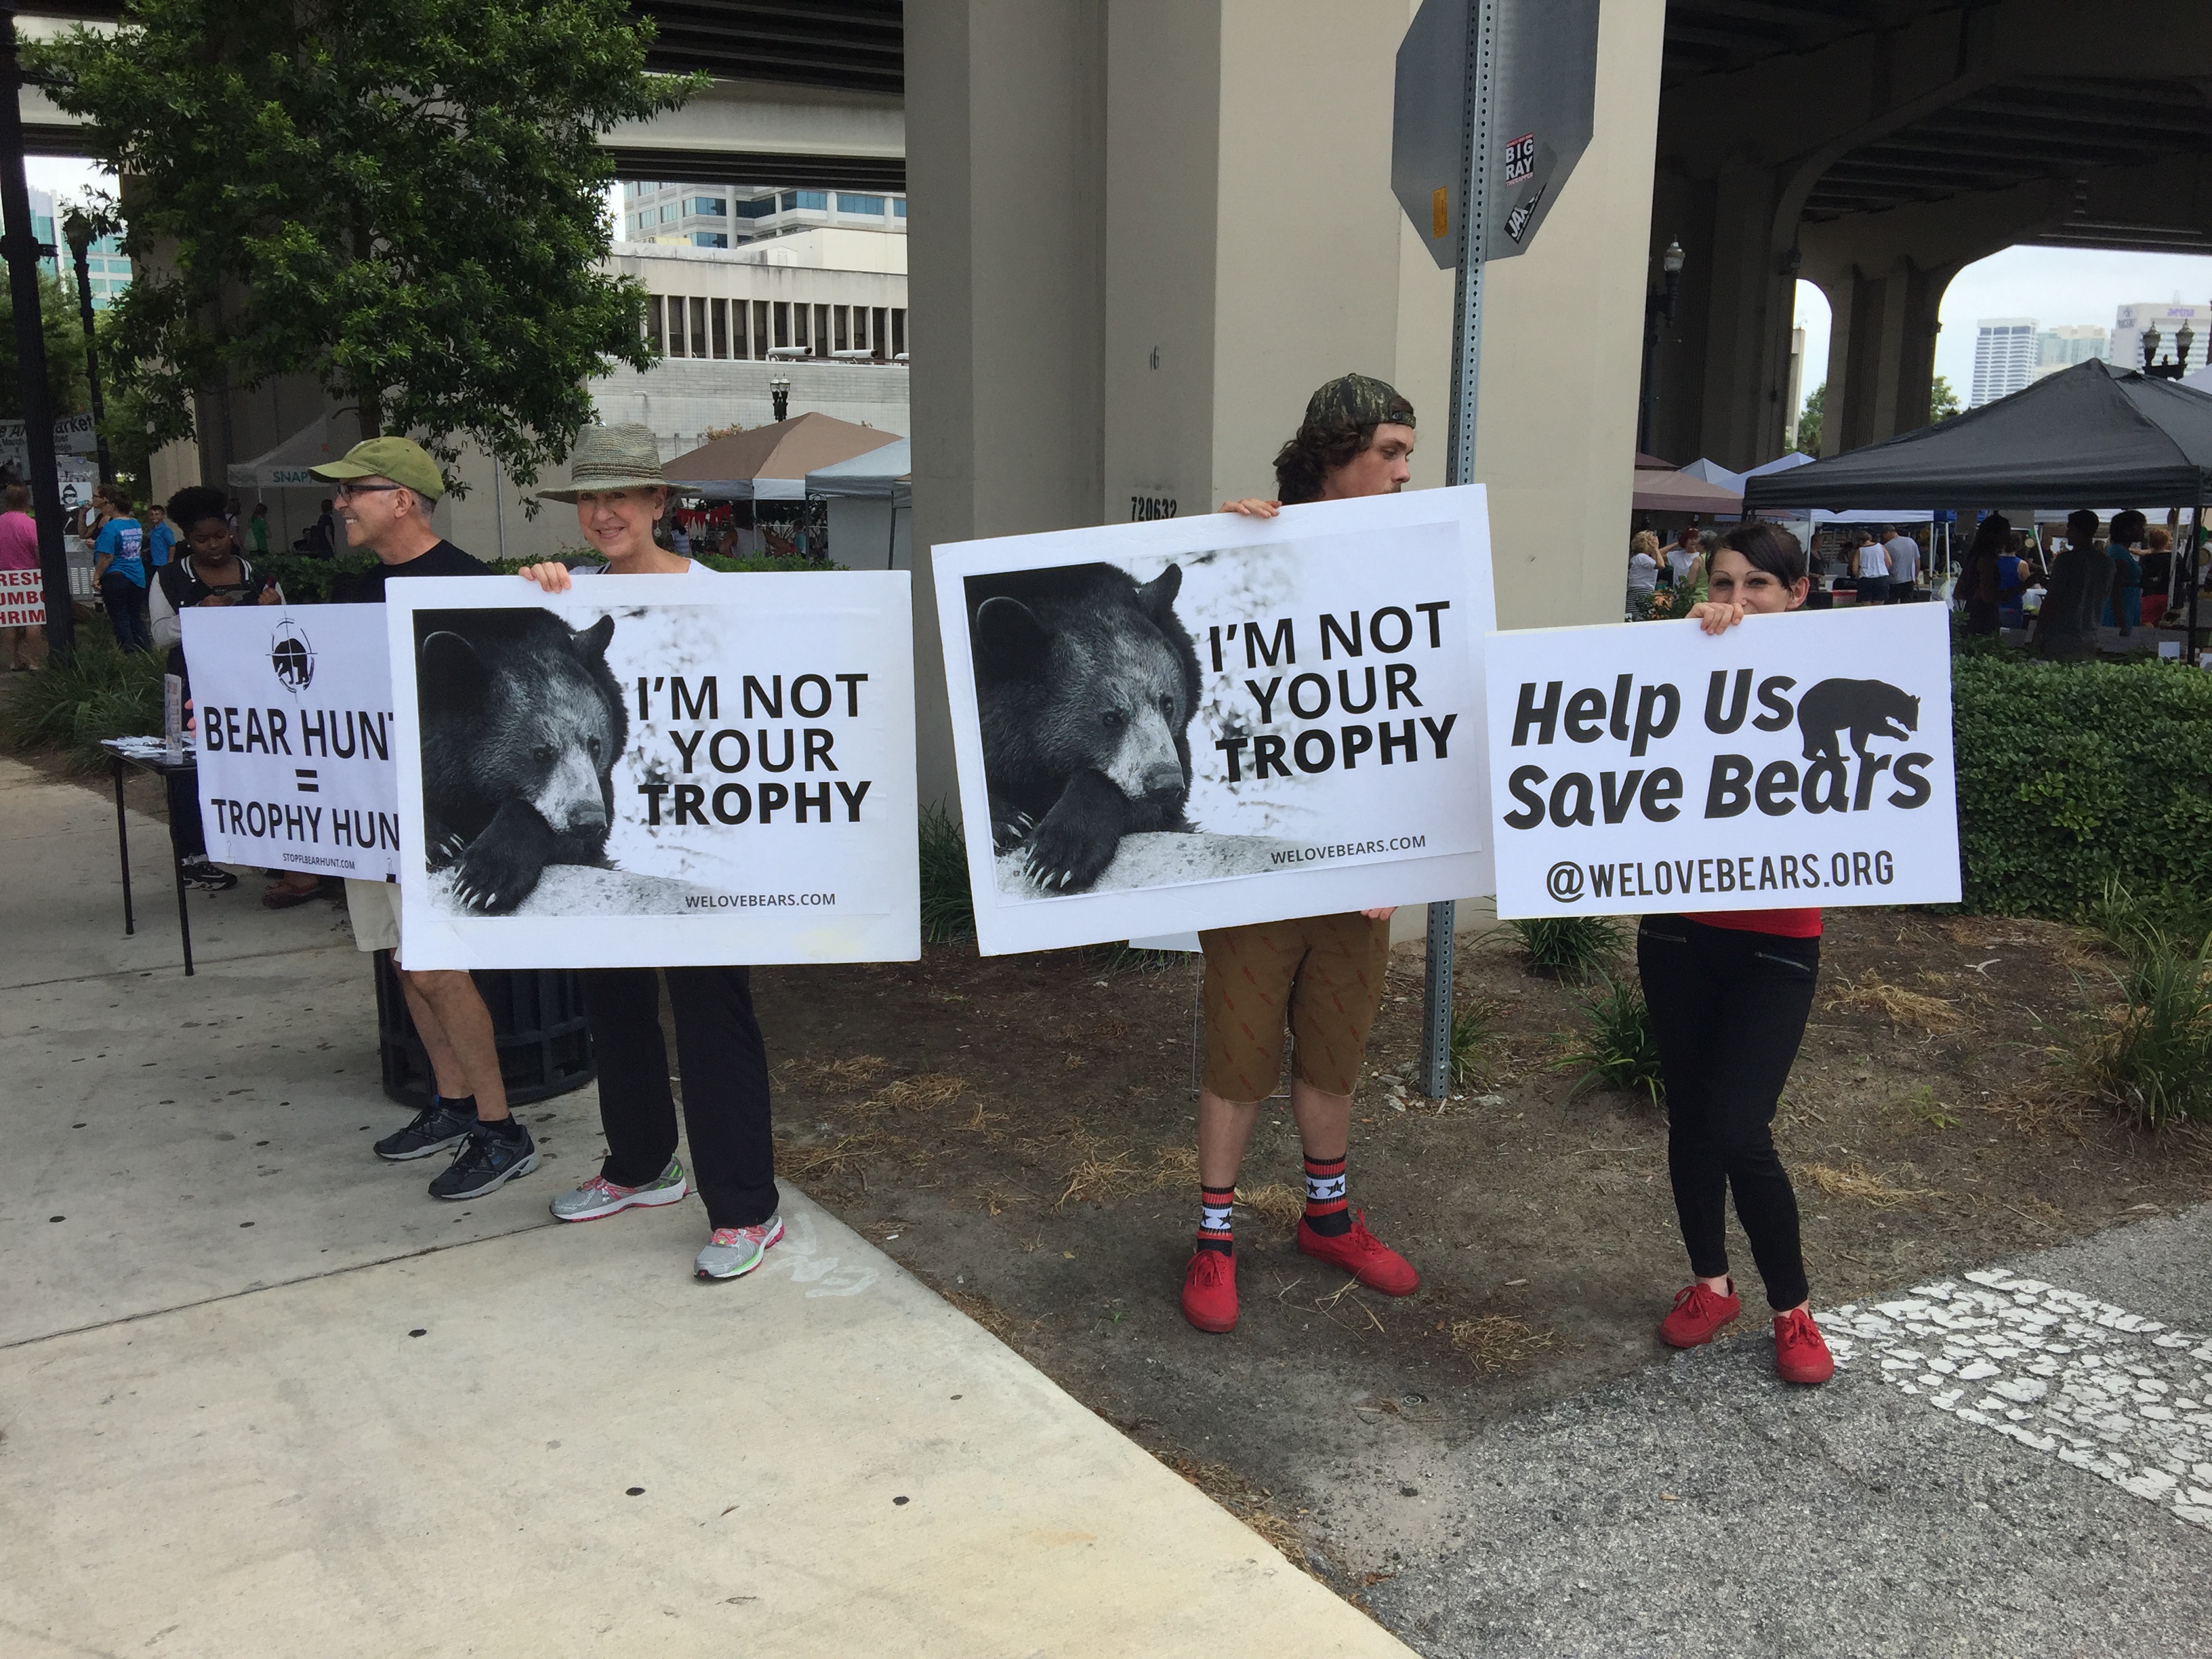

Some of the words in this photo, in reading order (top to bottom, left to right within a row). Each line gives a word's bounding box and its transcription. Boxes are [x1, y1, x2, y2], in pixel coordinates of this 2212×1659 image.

[1506, 139, 1534, 163] BIG
[1506, 155, 1534, 181] RAY
[273, 471, 311, 483] SNAP
[1131, 496, 1177, 521] 720632
[1209, 617, 1296, 673] I'M
[1319, 600, 1450, 661] NOT
[637, 676, 718, 720] I'M
[742, 674, 869, 719] NOT
[1244, 663, 1423, 724] YOUR
[1511, 673, 1681, 757] Help
[1704, 668, 1797, 735] Us
[203, 706, 292, 756] BEAR
[300, 709, 394, 761] HUN
[668, 728, 839, 774] YOUR
[1215, 714, 1458, 783] TROPHY
[638, 781, 872, 826] TROPHY
[1502, 764, 1683, 830] Save
[1704, 752, 1935, 819] Bears
[211, 798, 322, 843] TROPHY
[332, 808, 400, 851] HUN
[283, 853, 355, 869] STOPFLBEARHUNT.COM
[1271, 835, 1426, 865] WELOVEBEARS.COM
[1547, 850, 1893, 903] @WELOVEBEARS.ORG
[685, 893, 836, 908] WELOVEBEARS.COM
